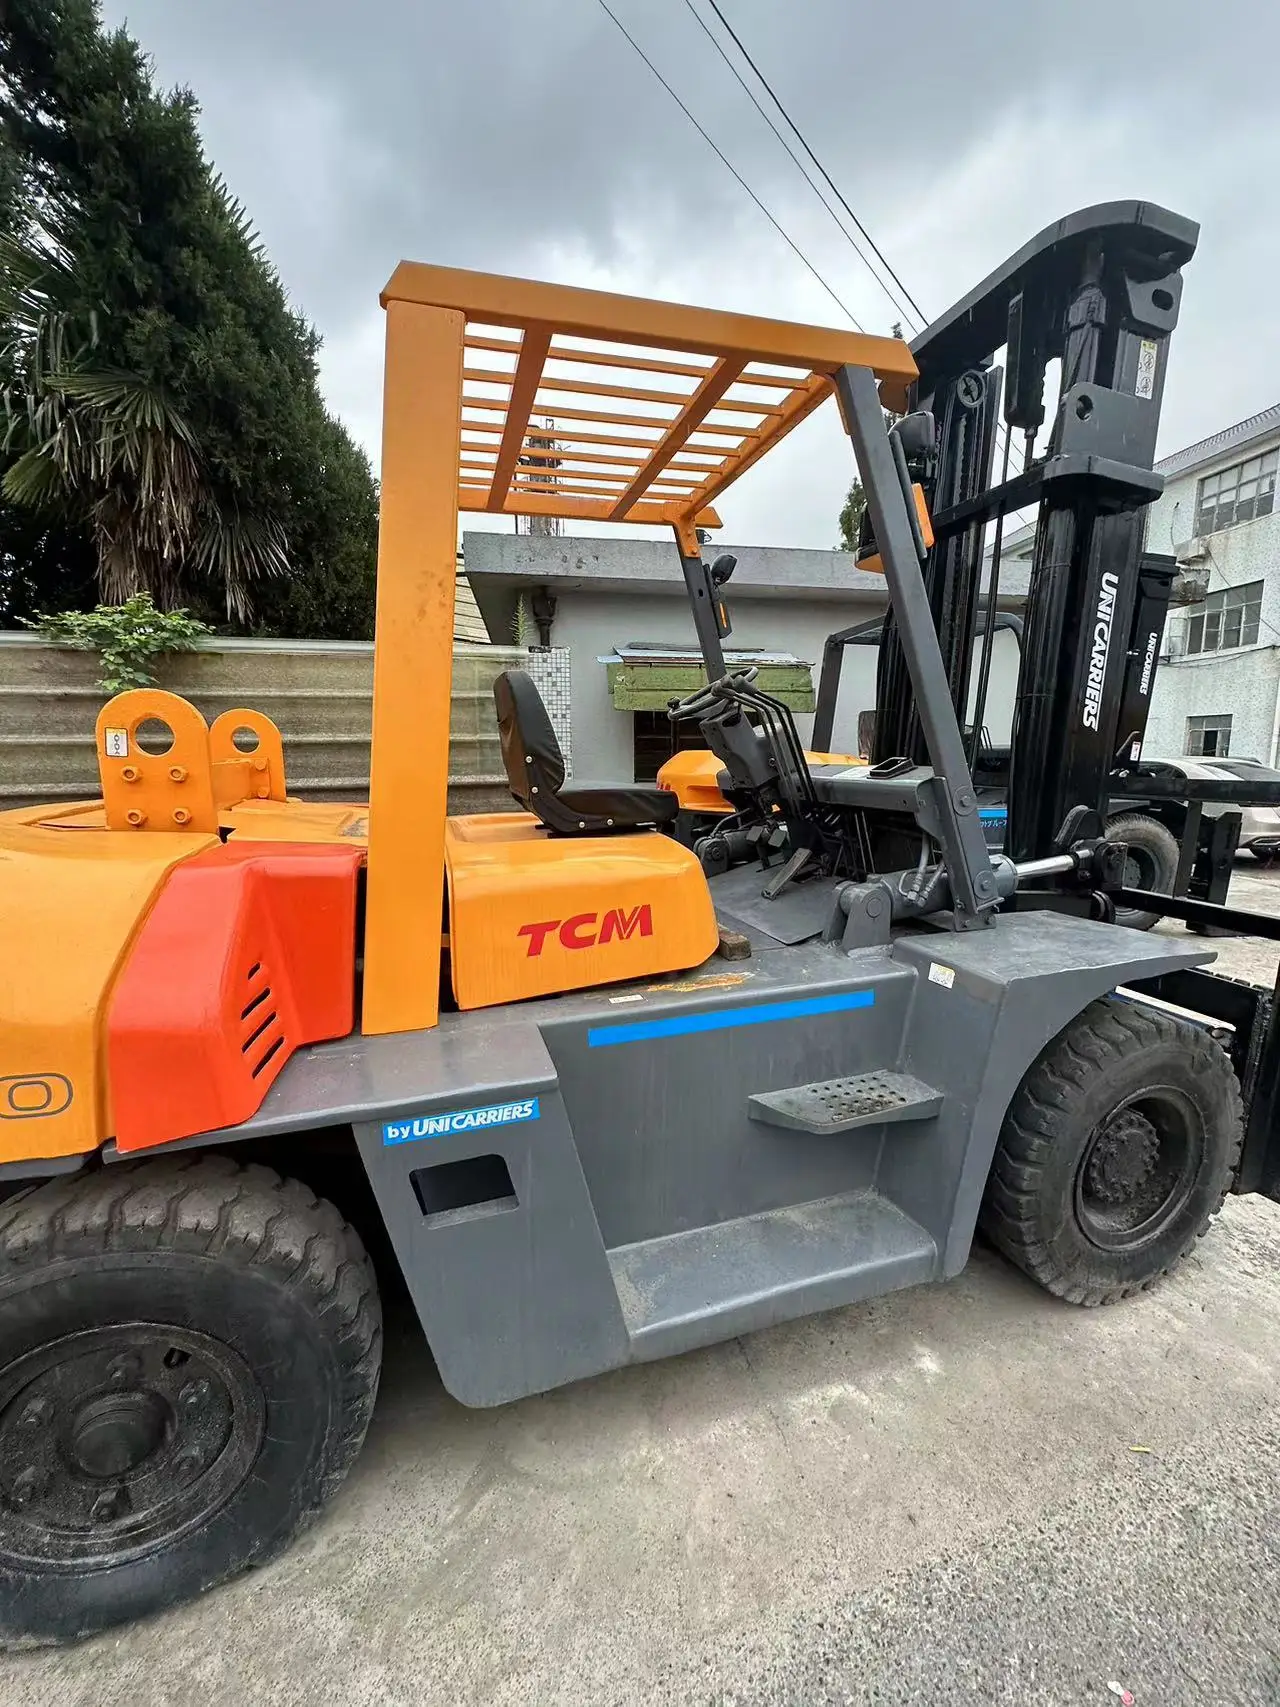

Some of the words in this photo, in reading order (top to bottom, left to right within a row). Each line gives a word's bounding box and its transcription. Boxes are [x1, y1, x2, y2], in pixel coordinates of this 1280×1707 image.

[1083, 571, 1119, 731] UNICARRIERS
[1139, 632, 1158, 696] UNICARRIERS
[517, 904, 653, 957] TCM
[387, 1126, 411, 1139] by
[412, 1100, 535, 1136] UNICARRIERS
